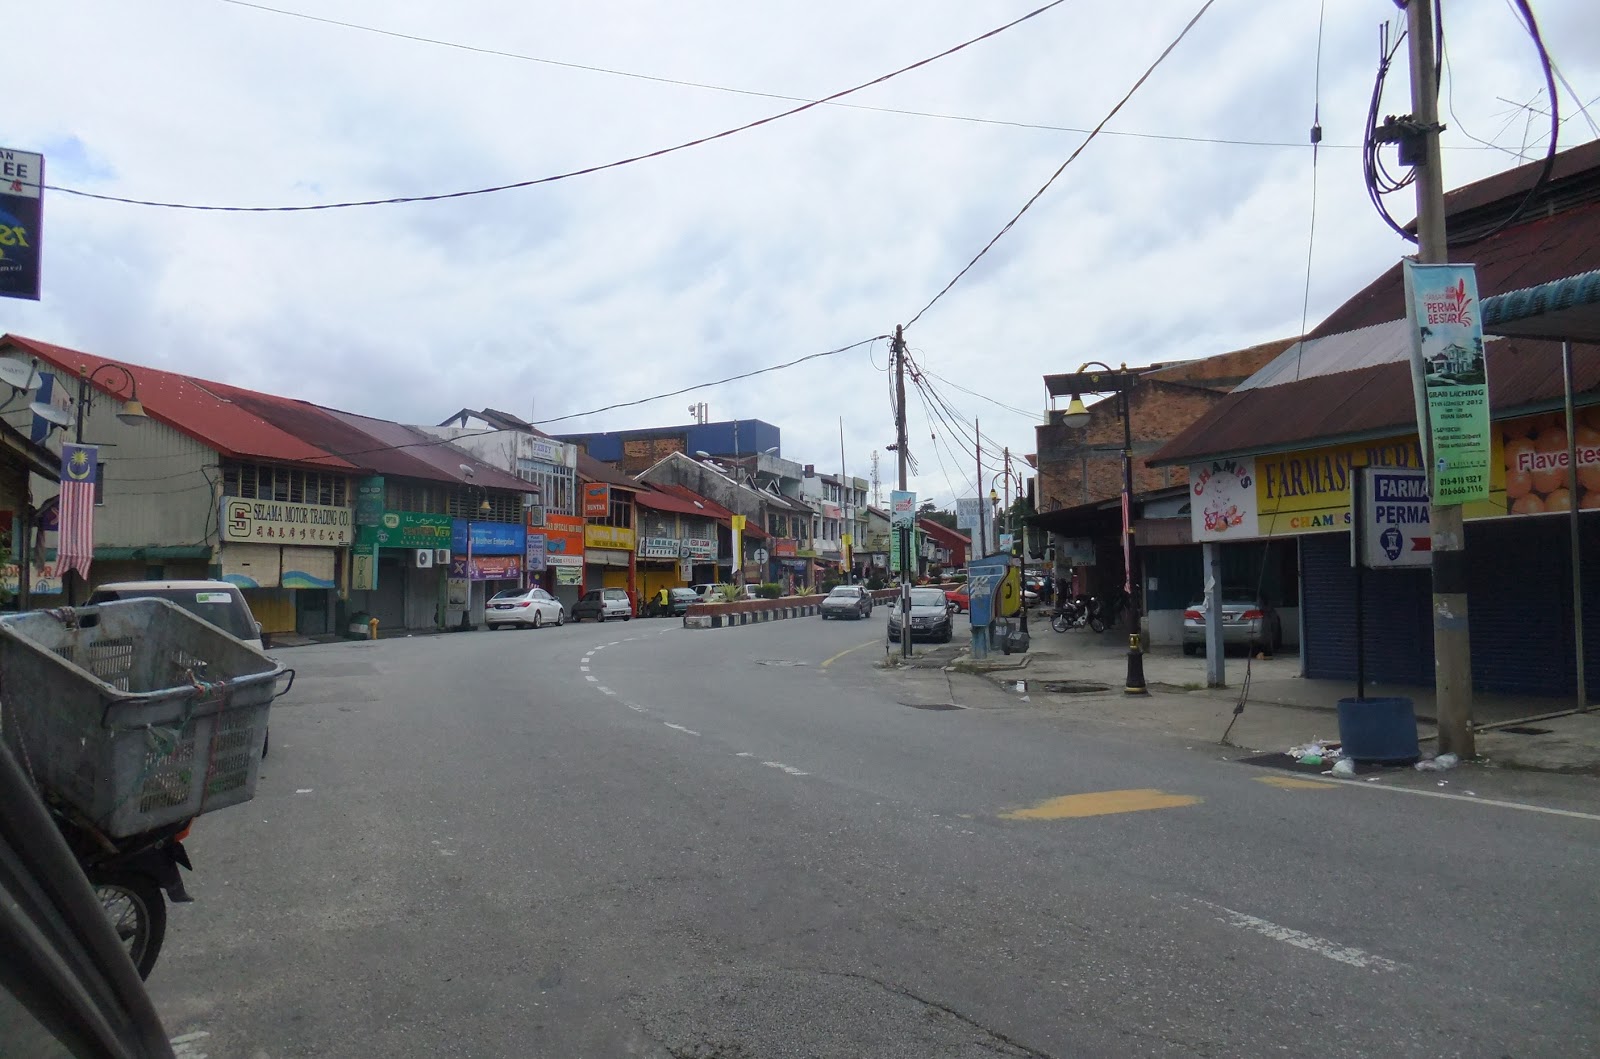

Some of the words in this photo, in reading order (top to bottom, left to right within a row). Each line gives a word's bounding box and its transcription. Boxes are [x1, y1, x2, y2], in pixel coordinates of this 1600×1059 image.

[1518, 447, 1600, 470] Flavete
[1194, 459, 1253, 496] CHAMPS
[254, 503, 282, 522] SELAMA
[285, 506, 308, 524] MOTOR
[310, 508, 337, 526] TRADING
[338, 511, 349, 527] CO.
